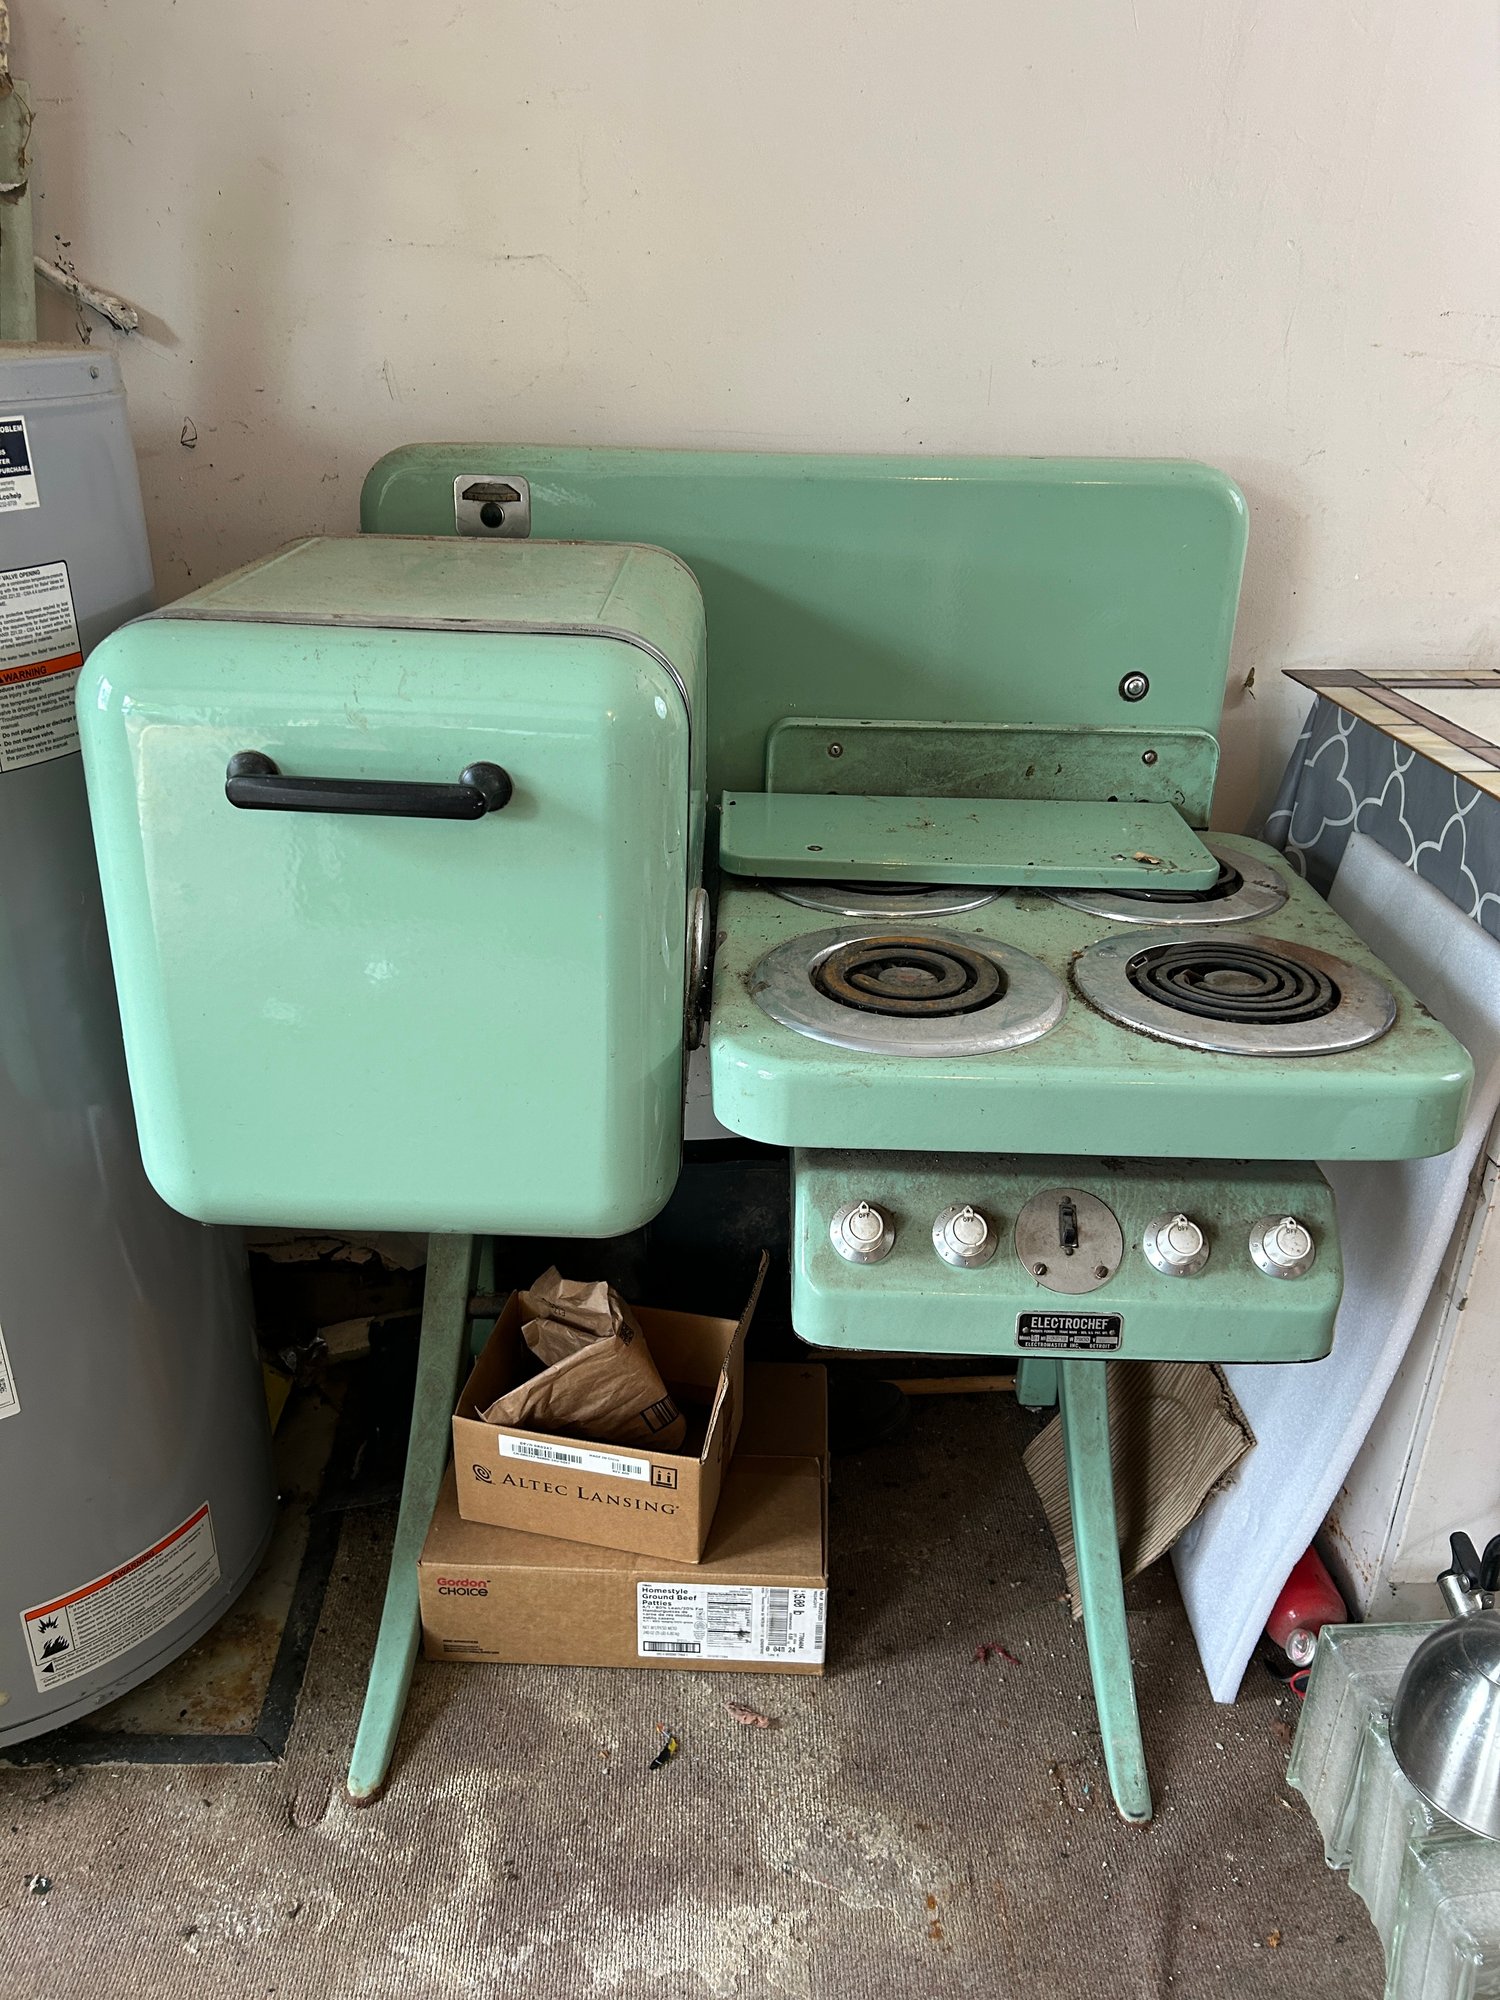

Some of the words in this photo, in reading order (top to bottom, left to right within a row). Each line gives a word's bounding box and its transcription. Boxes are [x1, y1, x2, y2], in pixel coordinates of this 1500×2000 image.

[4, 666, 47, 681] WARNING
[1030, 1316, 1109, 1330] ELECTROCHEF
[502, 1474, 568, 1496] ALTEC
[578, 1487, 675, 1515] LANSING
[118, 1551, 155, 1576] WARNING
[437, 1577, 487, 1588] Gordon
[642, 1587, 689, 1595] Homestyle
